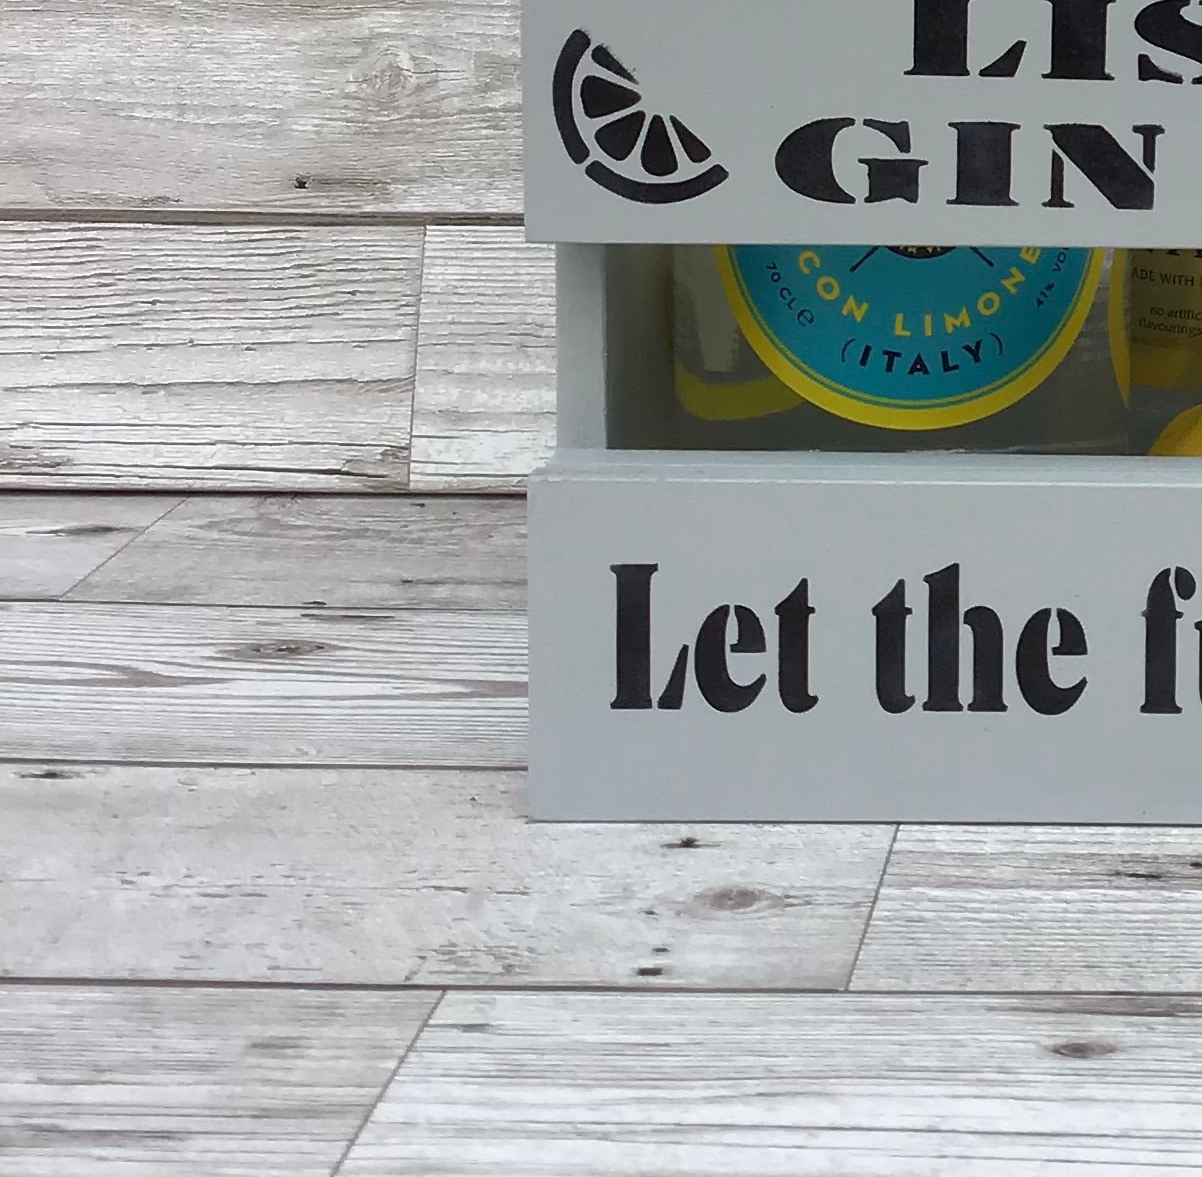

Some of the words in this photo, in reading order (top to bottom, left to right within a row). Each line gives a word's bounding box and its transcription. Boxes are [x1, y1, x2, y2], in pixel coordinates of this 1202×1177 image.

[775, 118, 1165, 210] GIN
[1052, 246, 1070, 272] VO
[1131, 267, 1156, 282] ADE
[1159, 271, 1194, 287] WITH
[765, 262, 781, 283] 70
[779, 287, 796, 311] CL
[797, 250, 869, 322] CON
[894, 246, 1041, 337] LIMONE
[1139, 317, 1201, 337] flavourings
[1150, 306, 1165, 317] no
[610, 563, 818, 713] Let
[872, 563, 1087, 715] the
